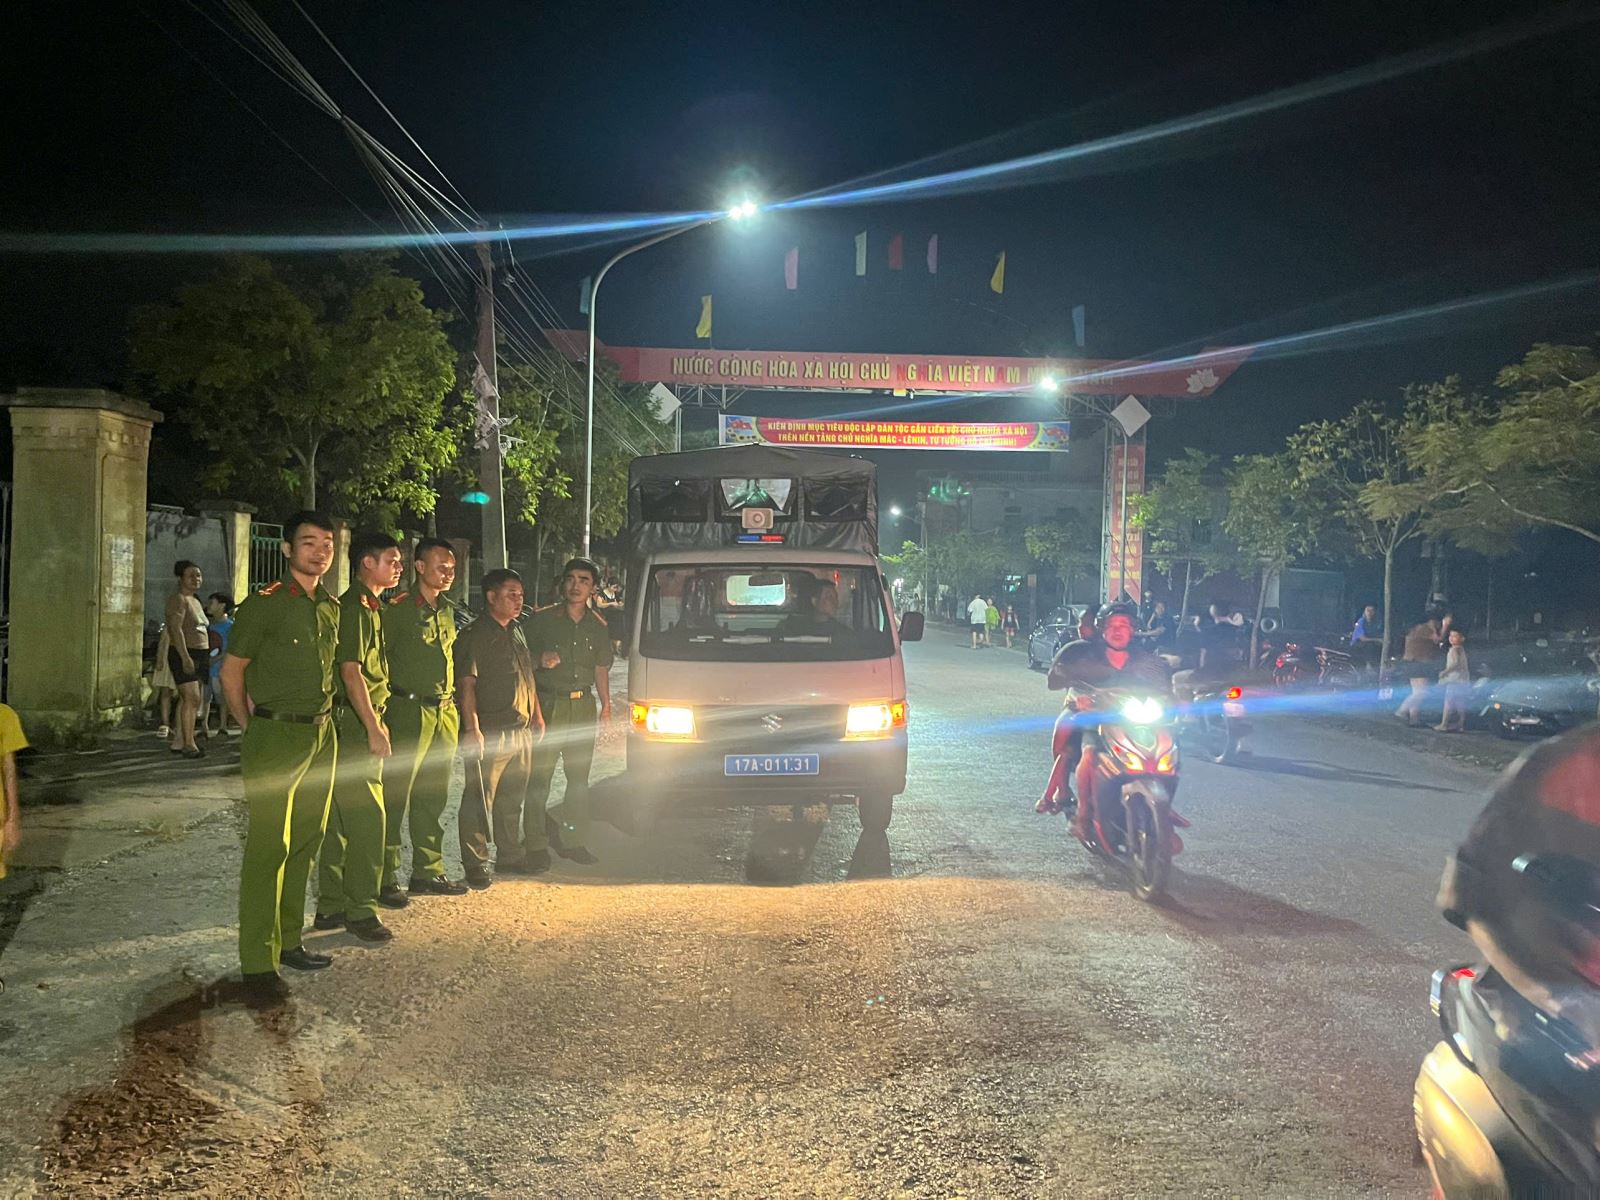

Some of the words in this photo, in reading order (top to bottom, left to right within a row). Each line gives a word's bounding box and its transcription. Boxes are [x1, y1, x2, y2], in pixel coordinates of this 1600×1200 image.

[673, 351, 714, 375] NƯỚC
[720, 353, 763, 382] CỘNG
[769, 354, 798, 378] HÒA
[804, 355, 824, 379] XÃ
[829, 355, 854, 384] HỘI
[860, 356, 890, 380] CHỦ
[949, 360, 980, 387] VIỆT
[808, 422, 824, 433] MỤC
[827, 421, 843, 432] TIÊU
[845, 421, 860, 434] ĐỘC
[838, 432, 853, 444] CHỦ
[855, 433, 878, 444] NGHĨA
[735, 758, 809, 772] 17A-011.31
